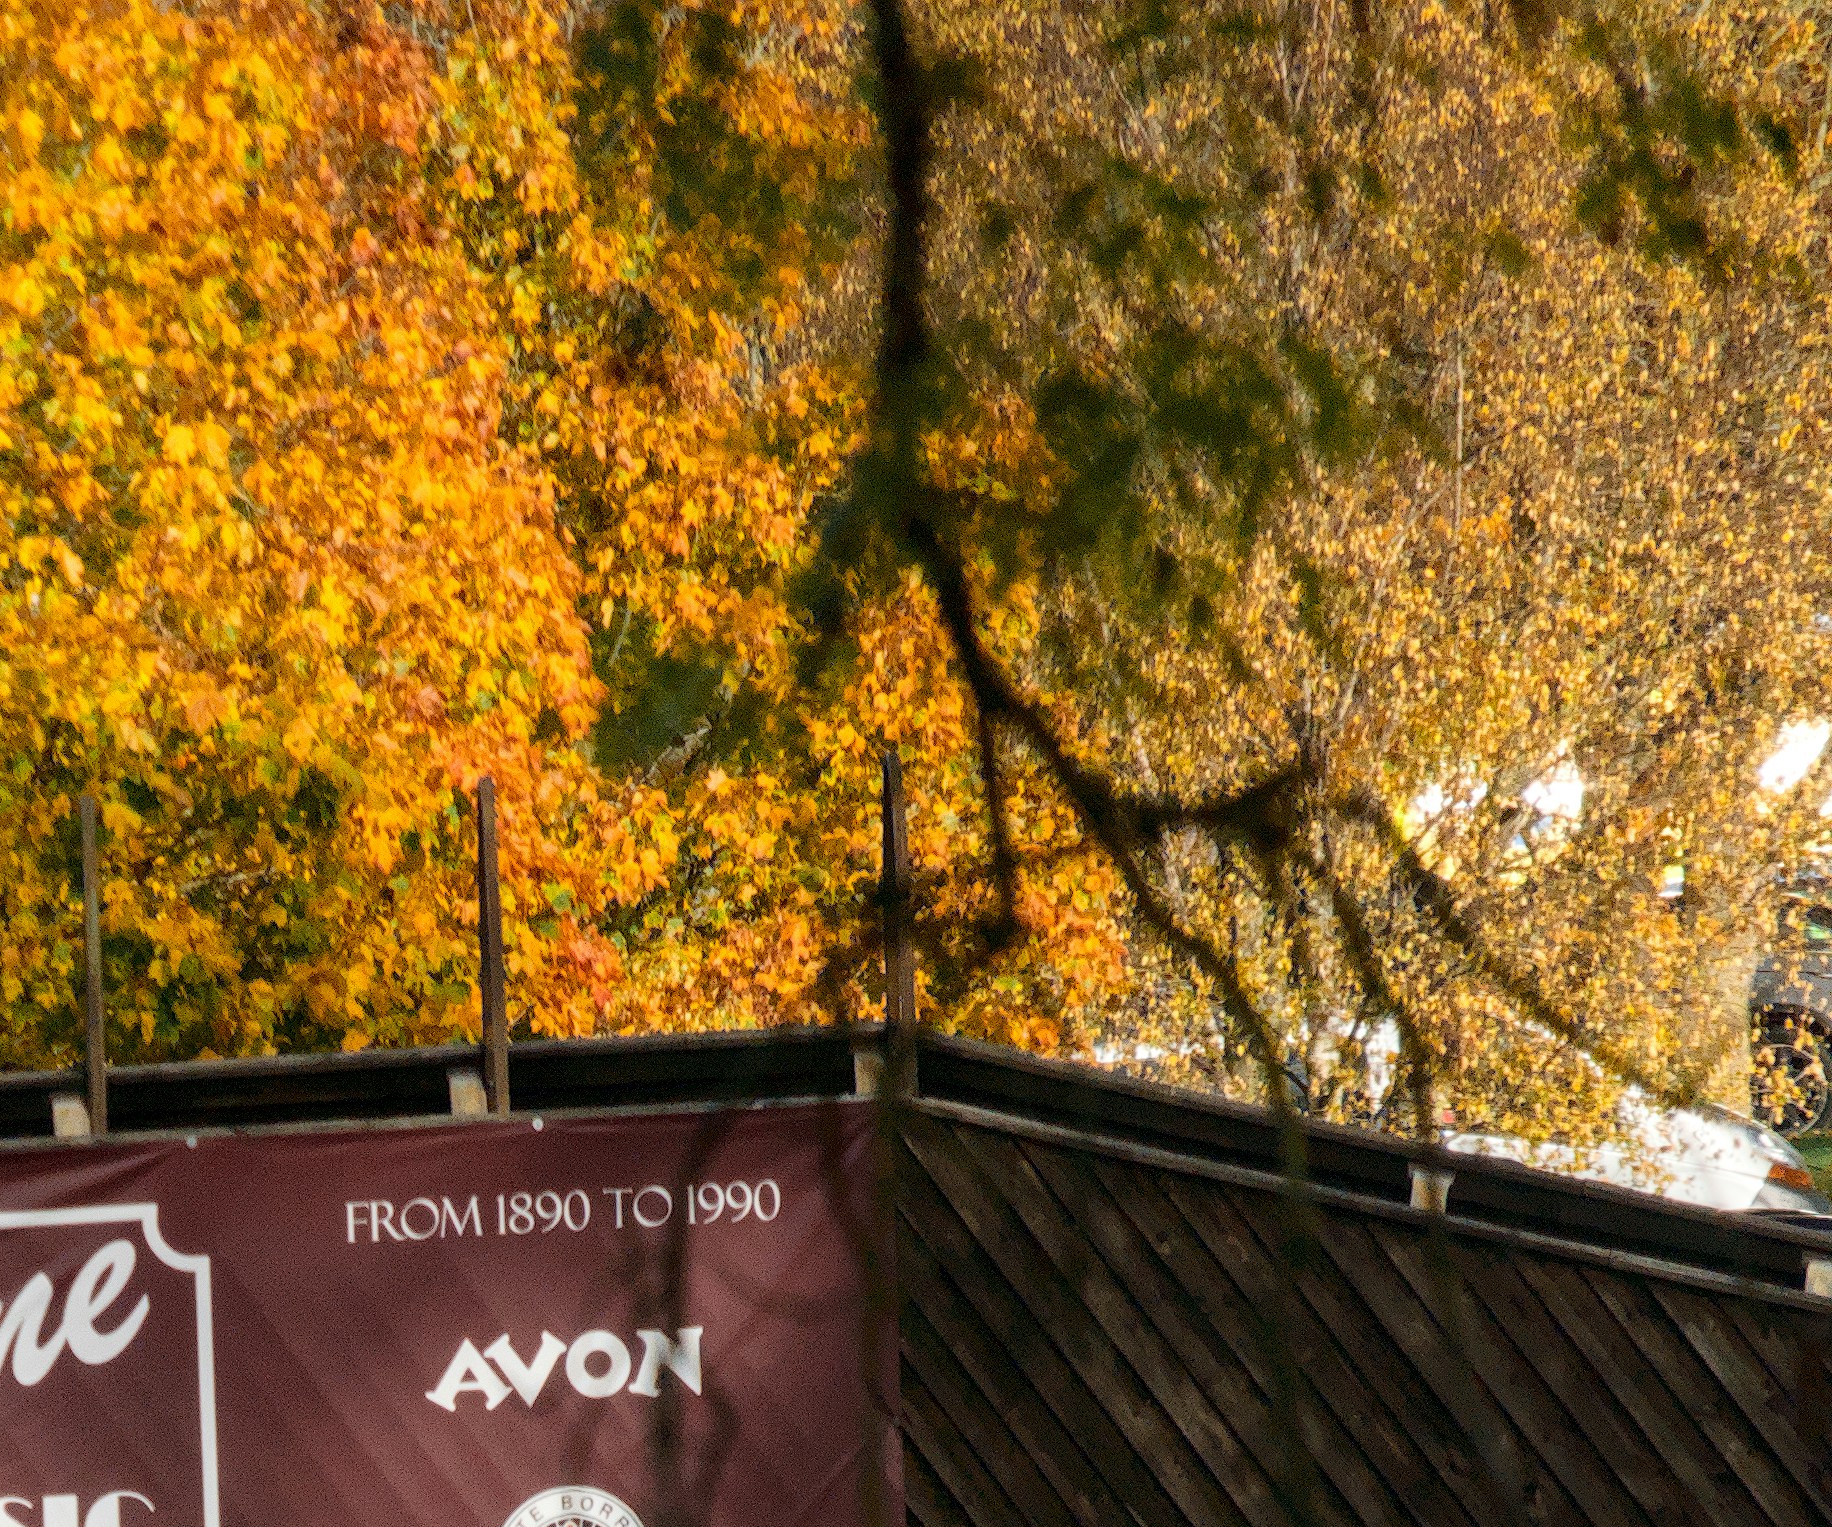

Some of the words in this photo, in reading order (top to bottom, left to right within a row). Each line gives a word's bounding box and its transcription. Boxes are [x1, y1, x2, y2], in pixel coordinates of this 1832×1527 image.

[345, 1196, 483, 1244] FROM
[498, 1189, 590, 1236] 1890
[603, 1184, 672, 1230] TO
[687, 1178, 781, 1226] 1990
[424, 1325, 704, 1413] AVON
